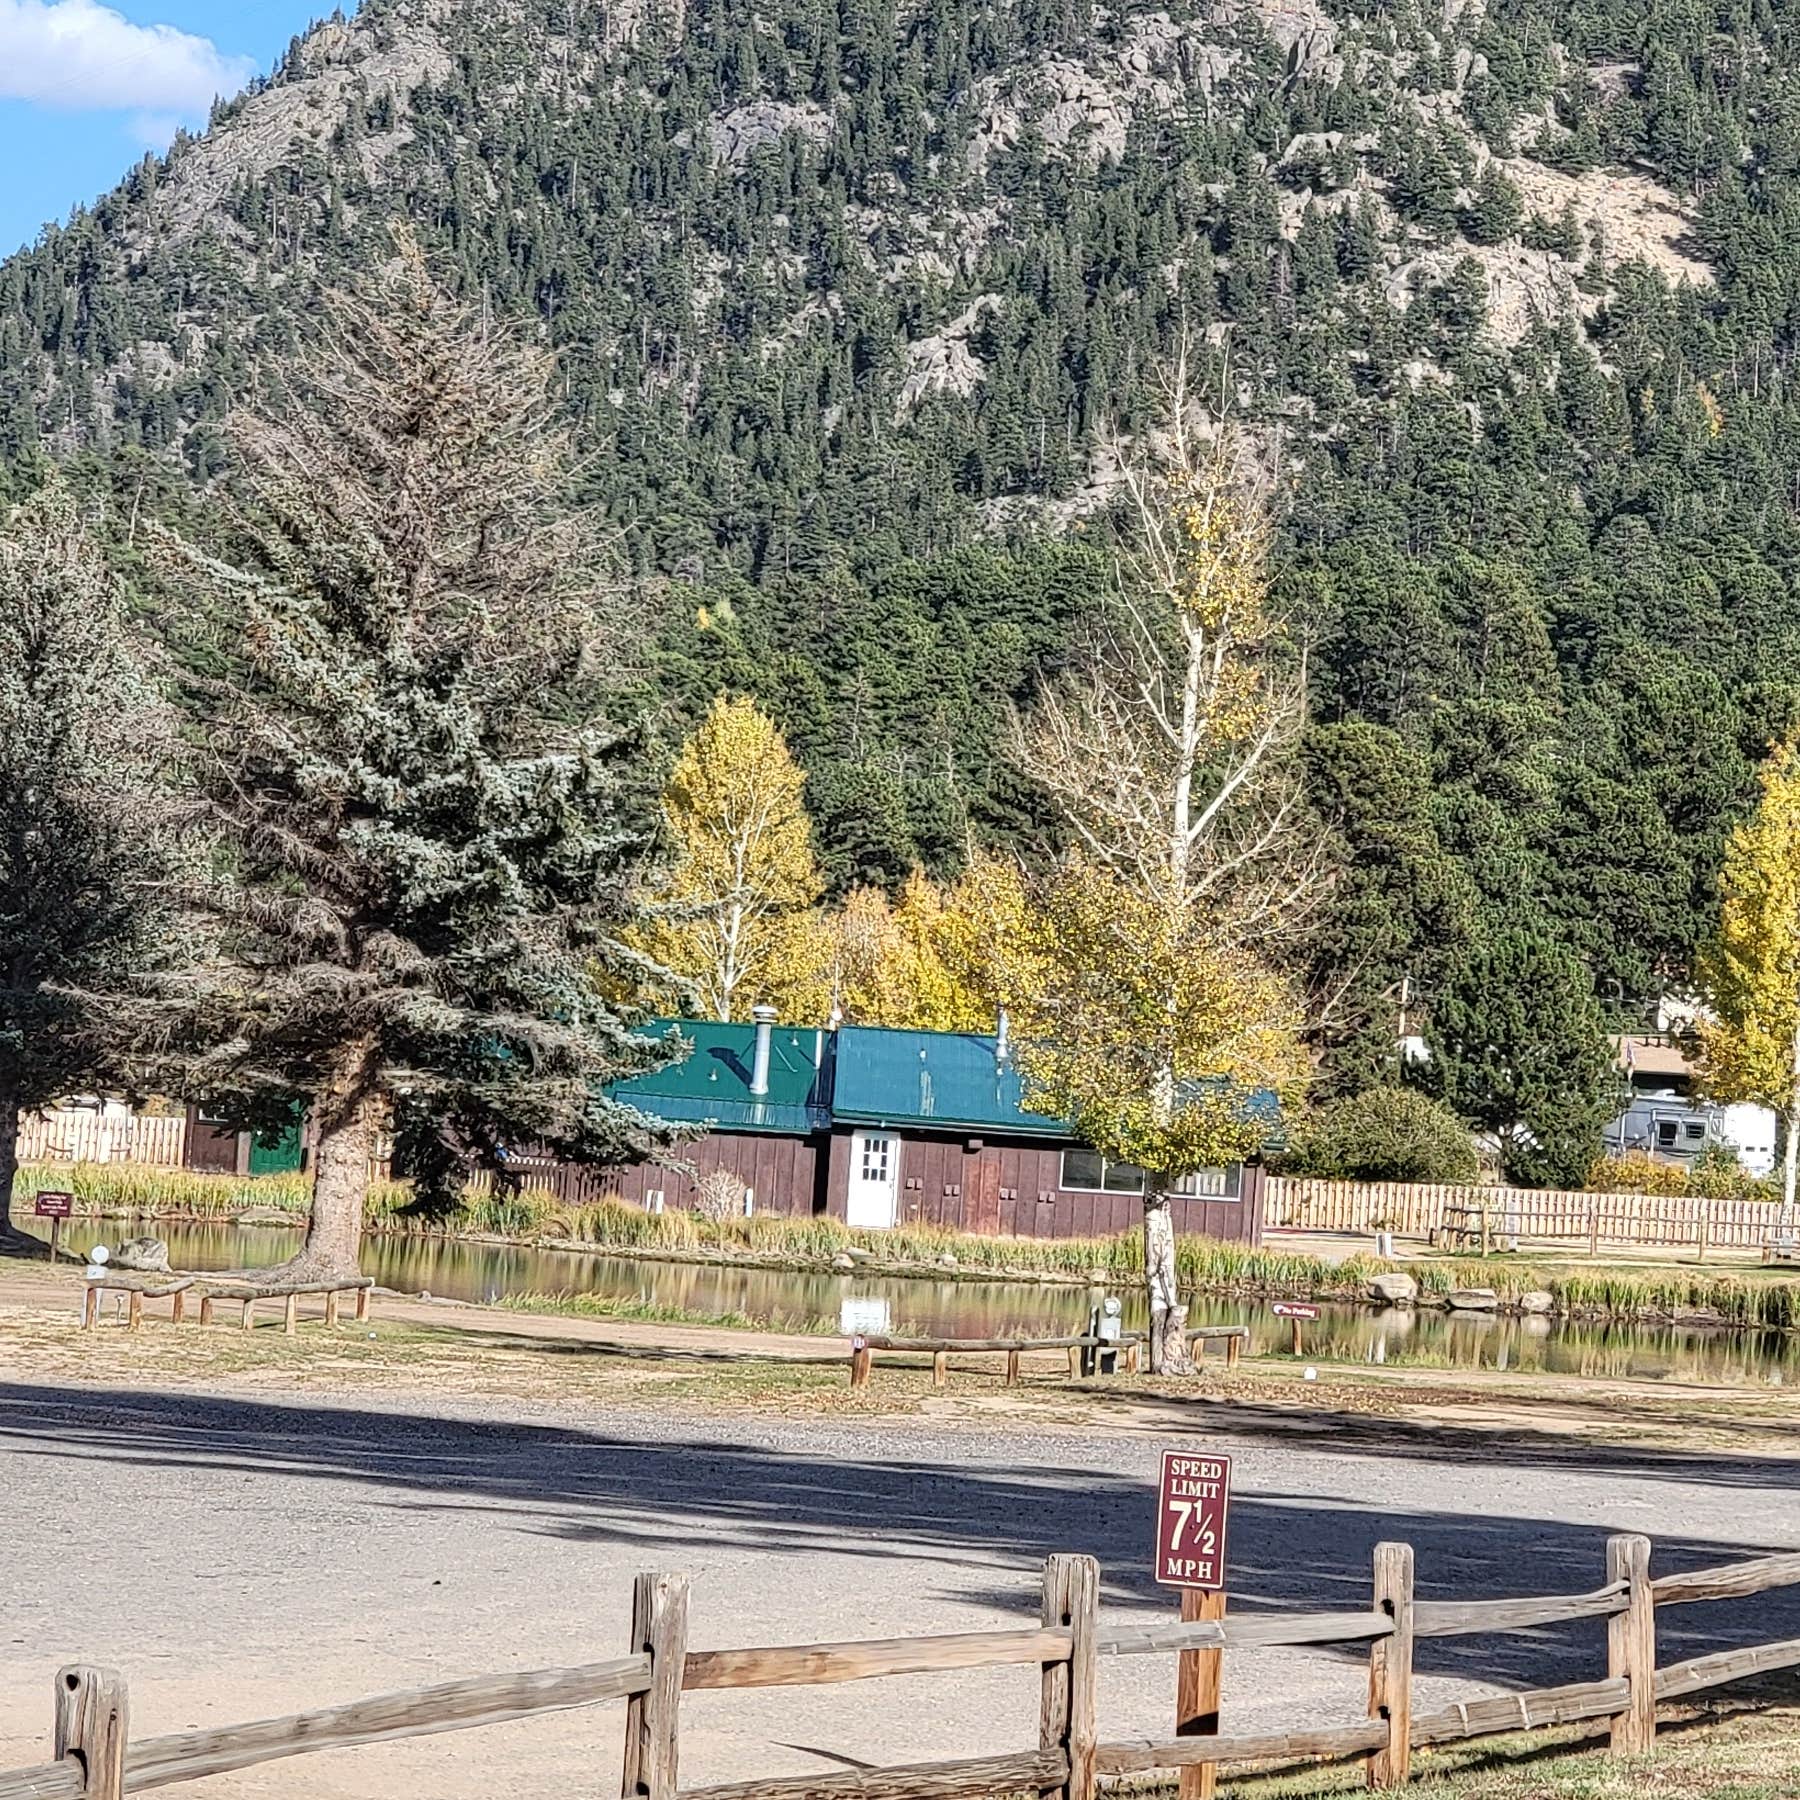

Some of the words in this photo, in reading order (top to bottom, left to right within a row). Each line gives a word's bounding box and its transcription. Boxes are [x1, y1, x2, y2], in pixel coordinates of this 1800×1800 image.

[1171, 1459, 1222, 1479] SPEED
[1170, 1479, 1220, 1499] LIMIT
[1167, 1558, 1213, 1579] MPH
